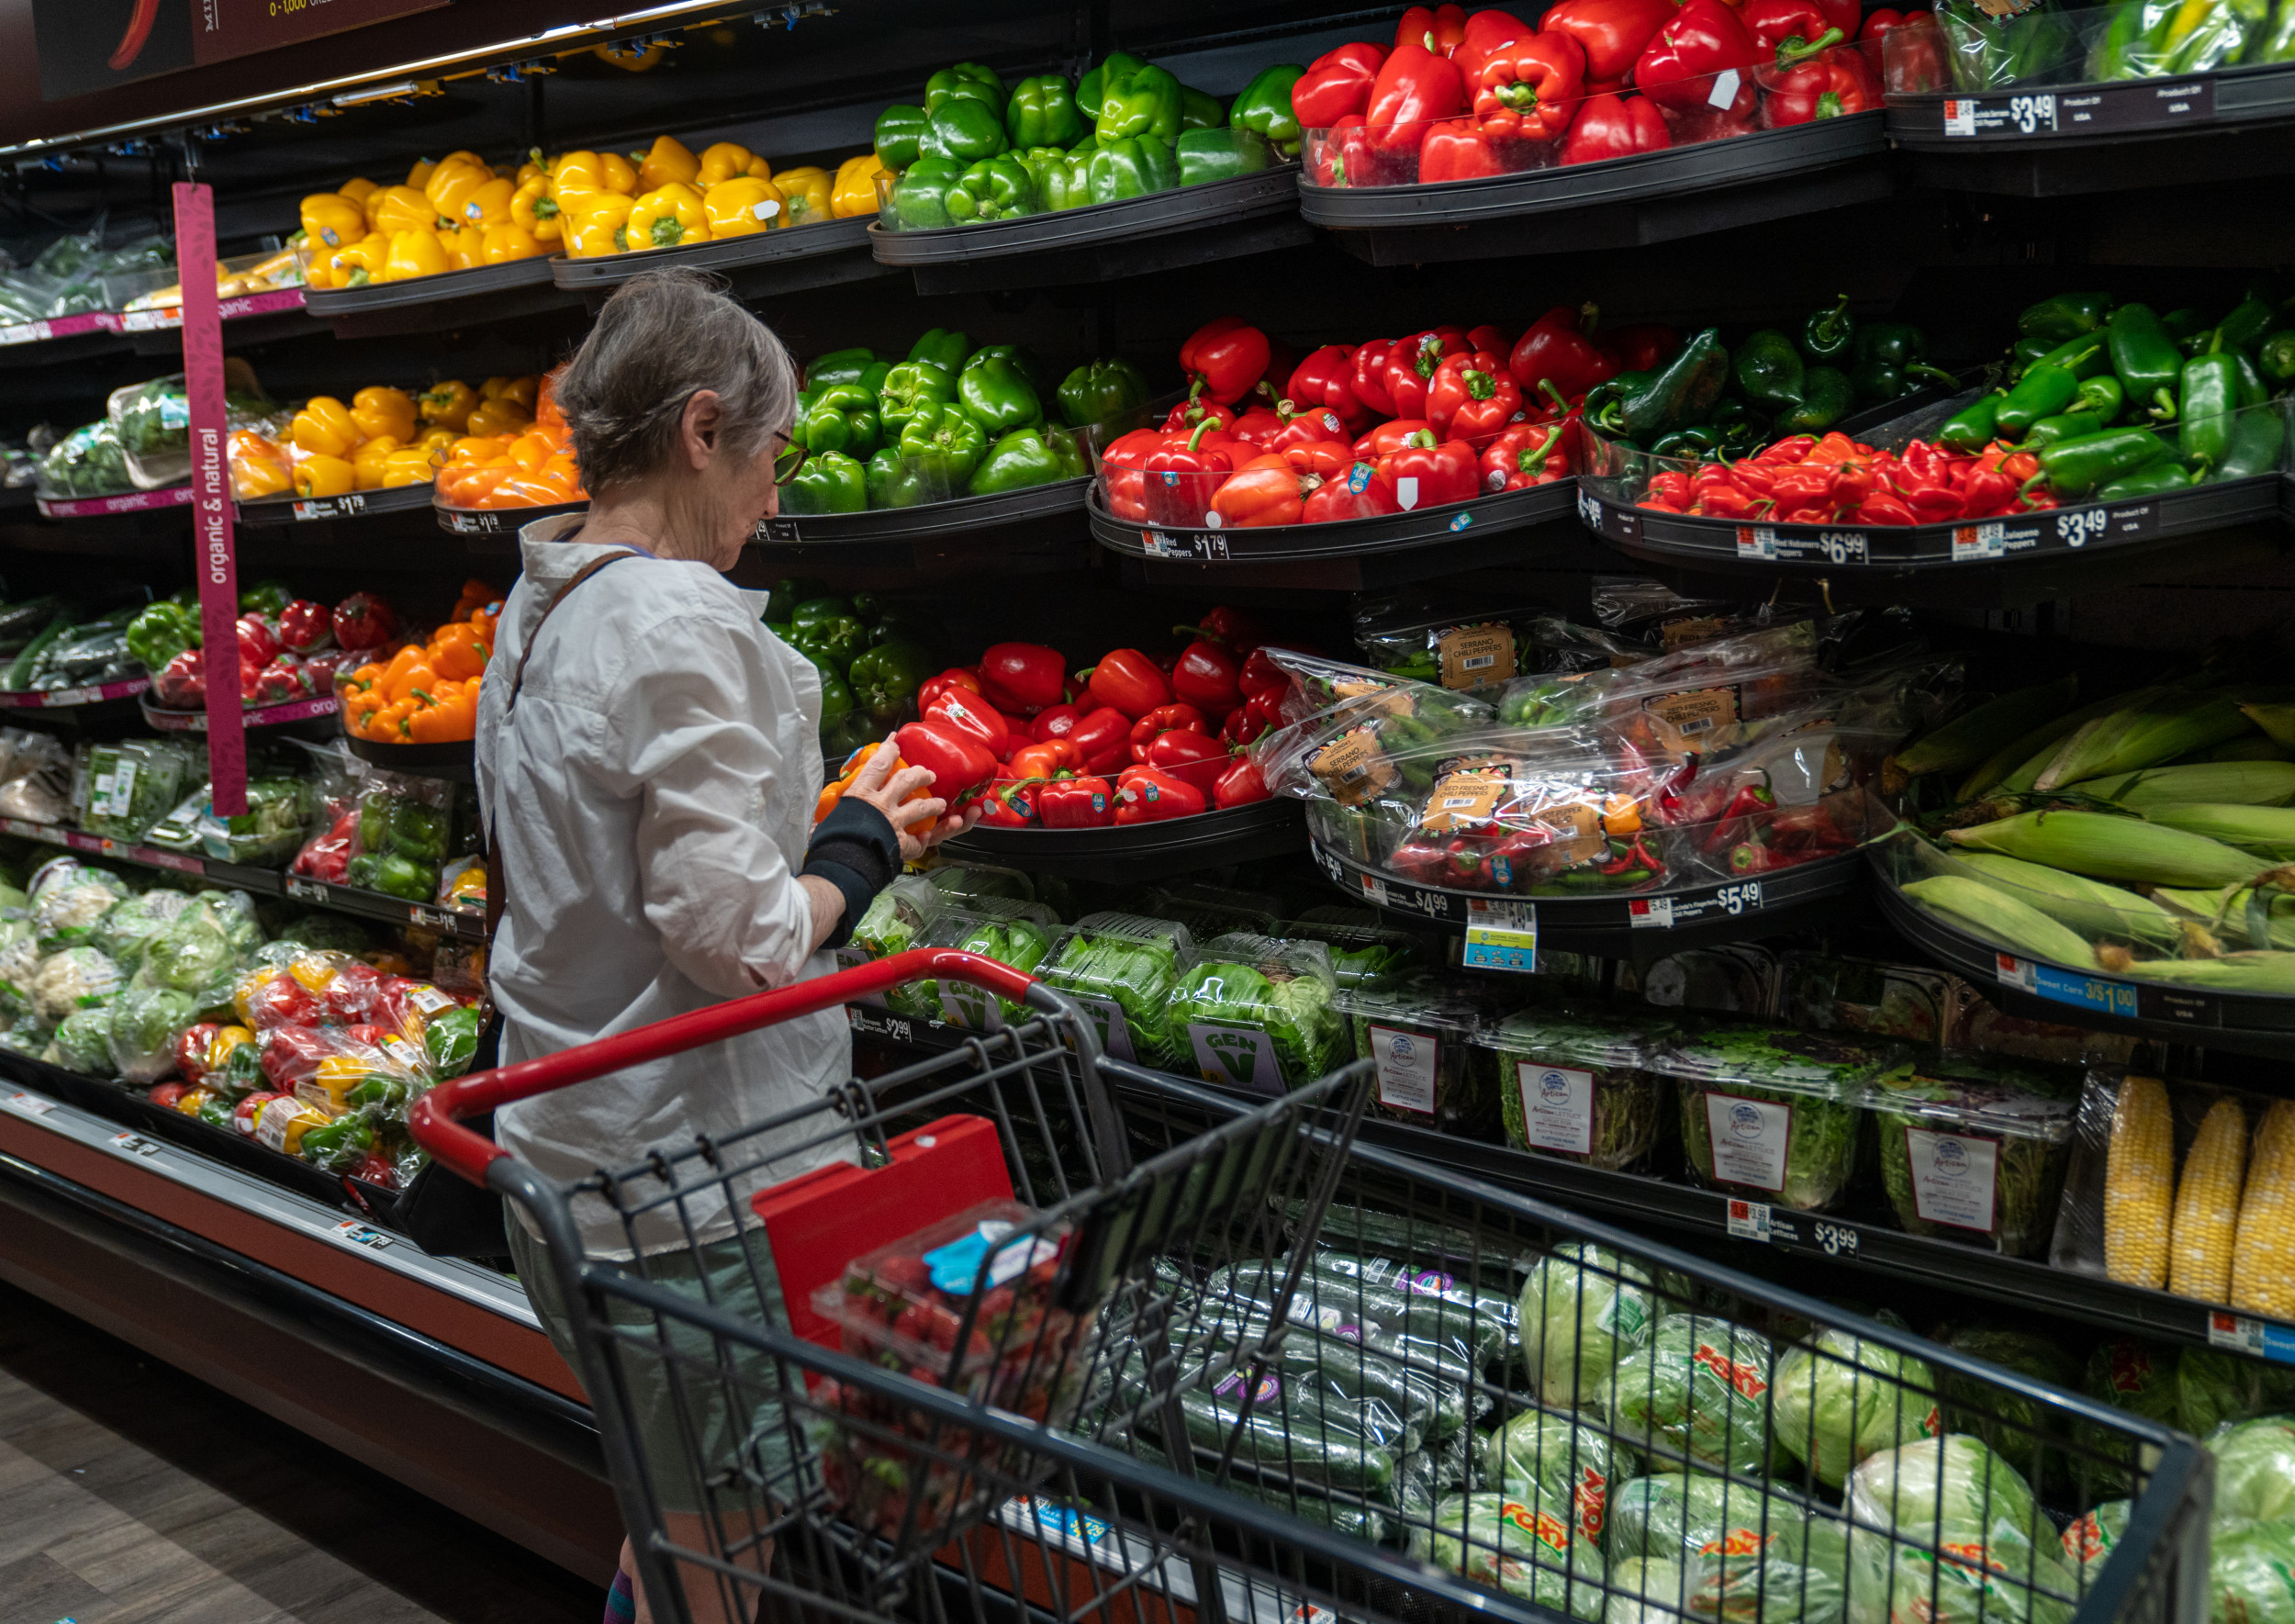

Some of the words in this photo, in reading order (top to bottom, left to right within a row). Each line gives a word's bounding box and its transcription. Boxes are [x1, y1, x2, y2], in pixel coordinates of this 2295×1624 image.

[198, 428, 221, 493] natural
[203, 498, 223, 512] &
[1166, 537, 1177, 546] Red
[204, 516, 230, 584] organic
[1168, 548, 1192, 558] Peppers
[1454, 649, 1472, 658] CHILI
[1473, 644, 1502, 655] PEPPERS
[1461, 638, 1494, 650] SERRANO
[1685, 700, 1717, 711] FRESNO
[1327, 765, 1343, 778] CHILI
[1343, 749, 1369, 770] PEPPERS
[1329, 747, 1360, 768] SERRANO
[1539, 811, 1555, 820] HOT
[1555, 806, 1582, 817] PEPPER
[1549, 815, 1572, 825] BLED
[948, 981, 986, 1004] GEN
[2035, 976, 2061, 991] Sweet
[2063, 984, 2083, 996] Corn
[1205, 1033, 1257, 1055] GEN
[1391, 1051, 1414, 1060] Artisan
[1214, 1049, 1256, 1083] V
[1383, 1066, 1403, 1076] Artisan
[1403, 1070, 1427, 1081] LETTUCE
[1541, 1089, 1568, 1098] Artisan
[1532, 1105, 1554, 1114] Artisan
[1770, 1219, 1795, 1230] Artisan
[1770, 1228, 1798, 1240] Lettuces
[1693, 1343, 1768, 1401] FOXY
[1502, 1503, 1569, 1550] FOXY
